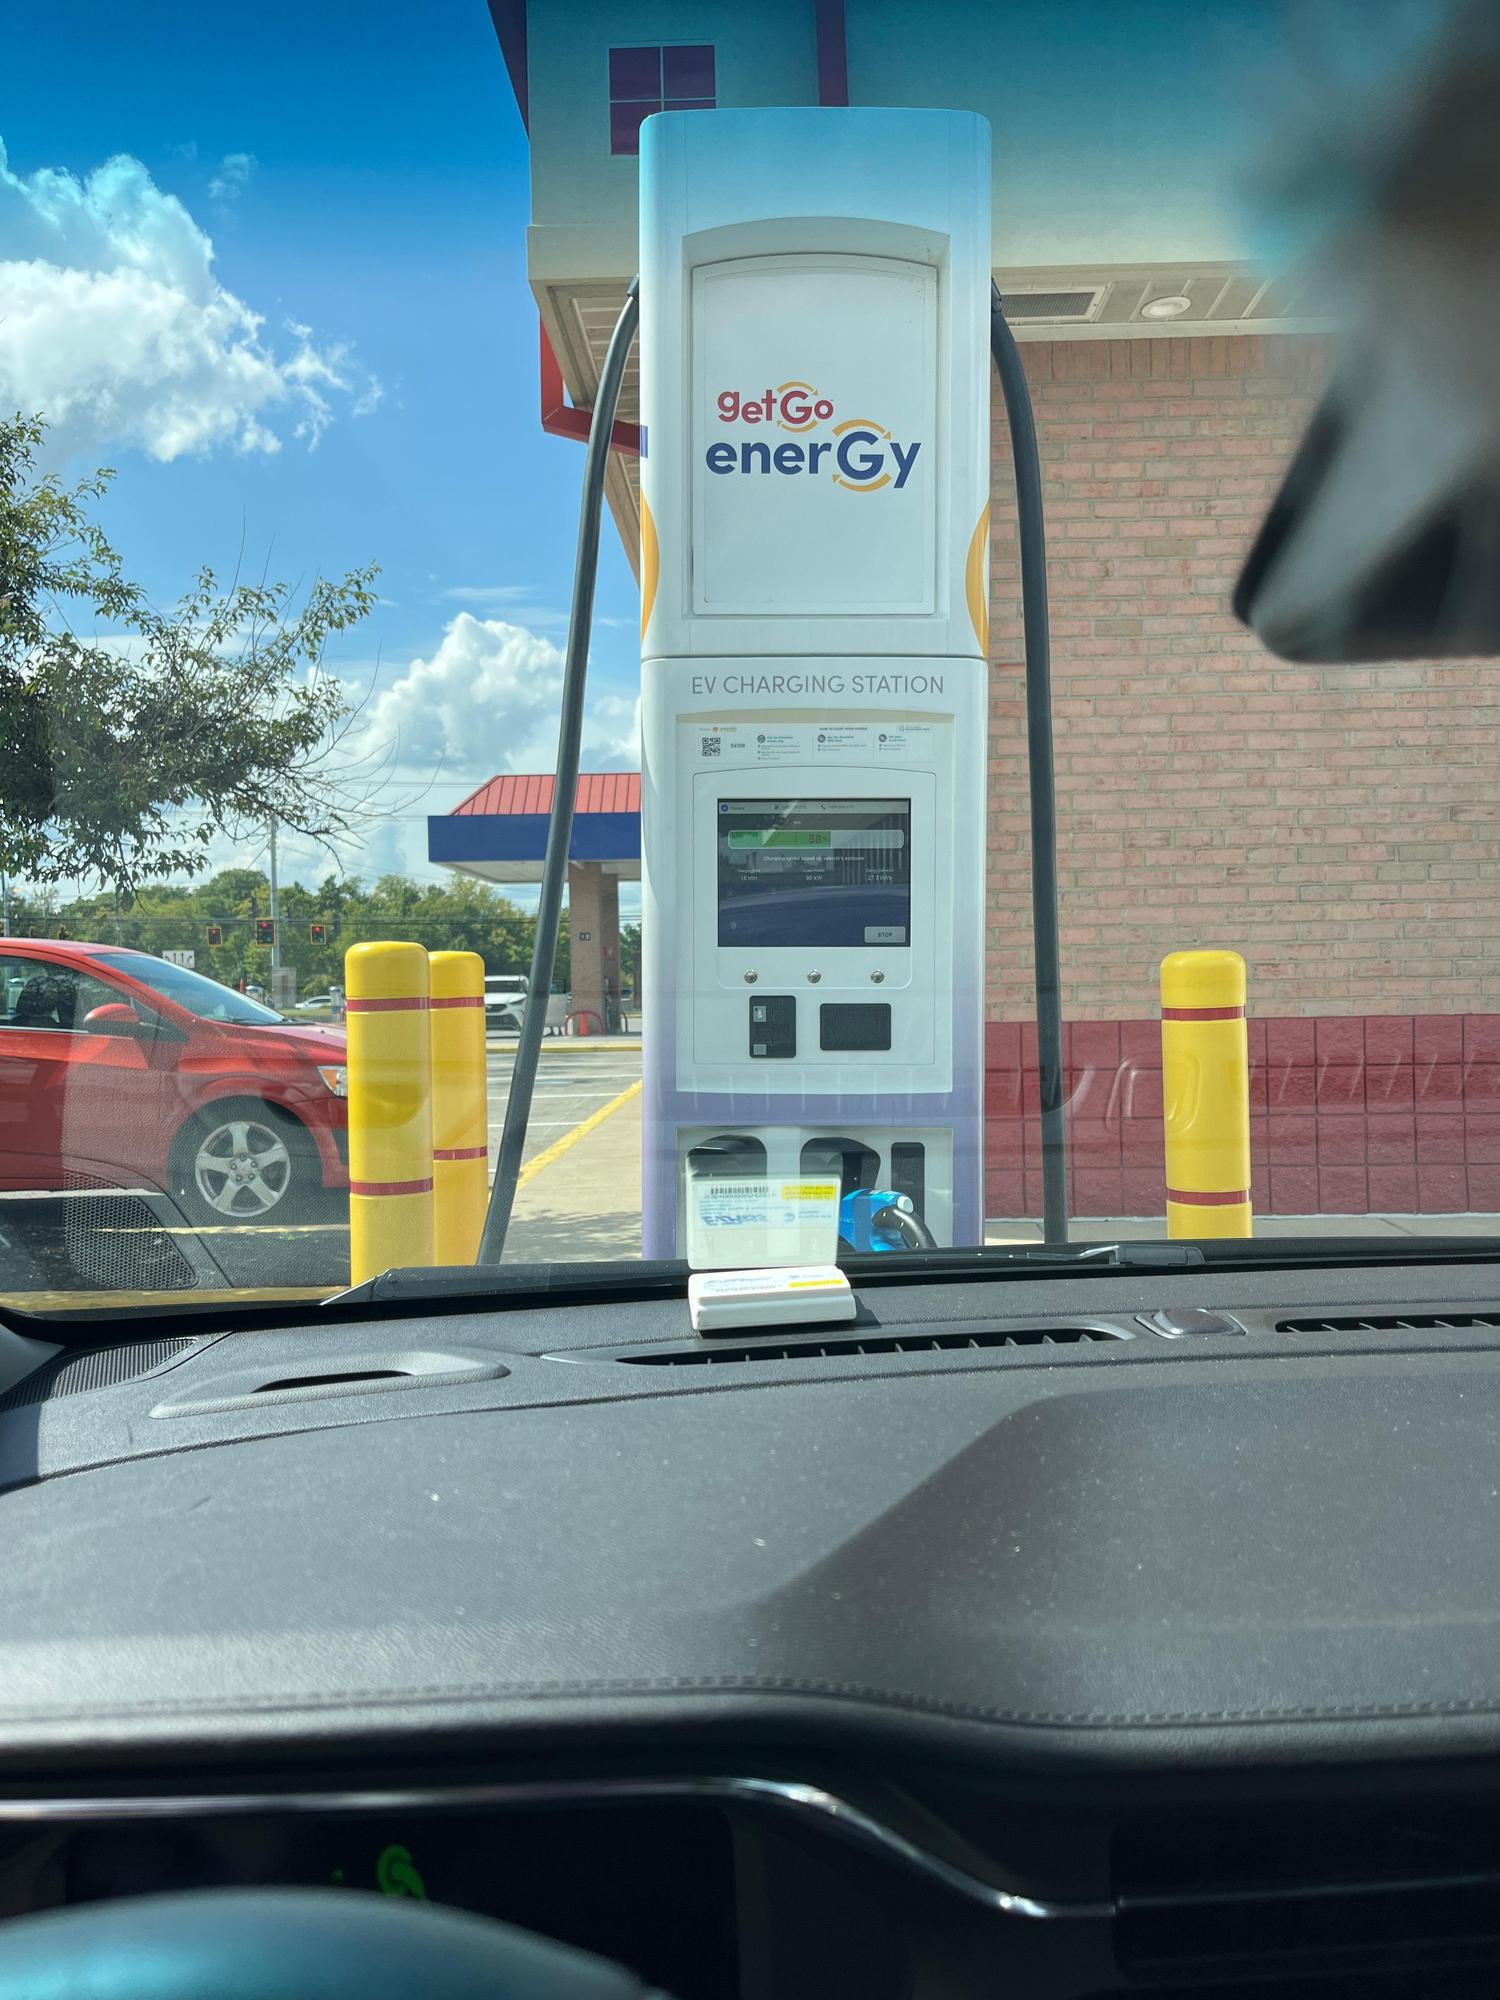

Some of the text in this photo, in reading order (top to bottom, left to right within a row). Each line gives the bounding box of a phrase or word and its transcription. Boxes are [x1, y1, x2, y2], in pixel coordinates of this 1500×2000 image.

[717, 390, 834, 425] getGo
[705, 431, 922, 489] enerGy
[692, 675, 944, 695] EV CHARGING STATION
